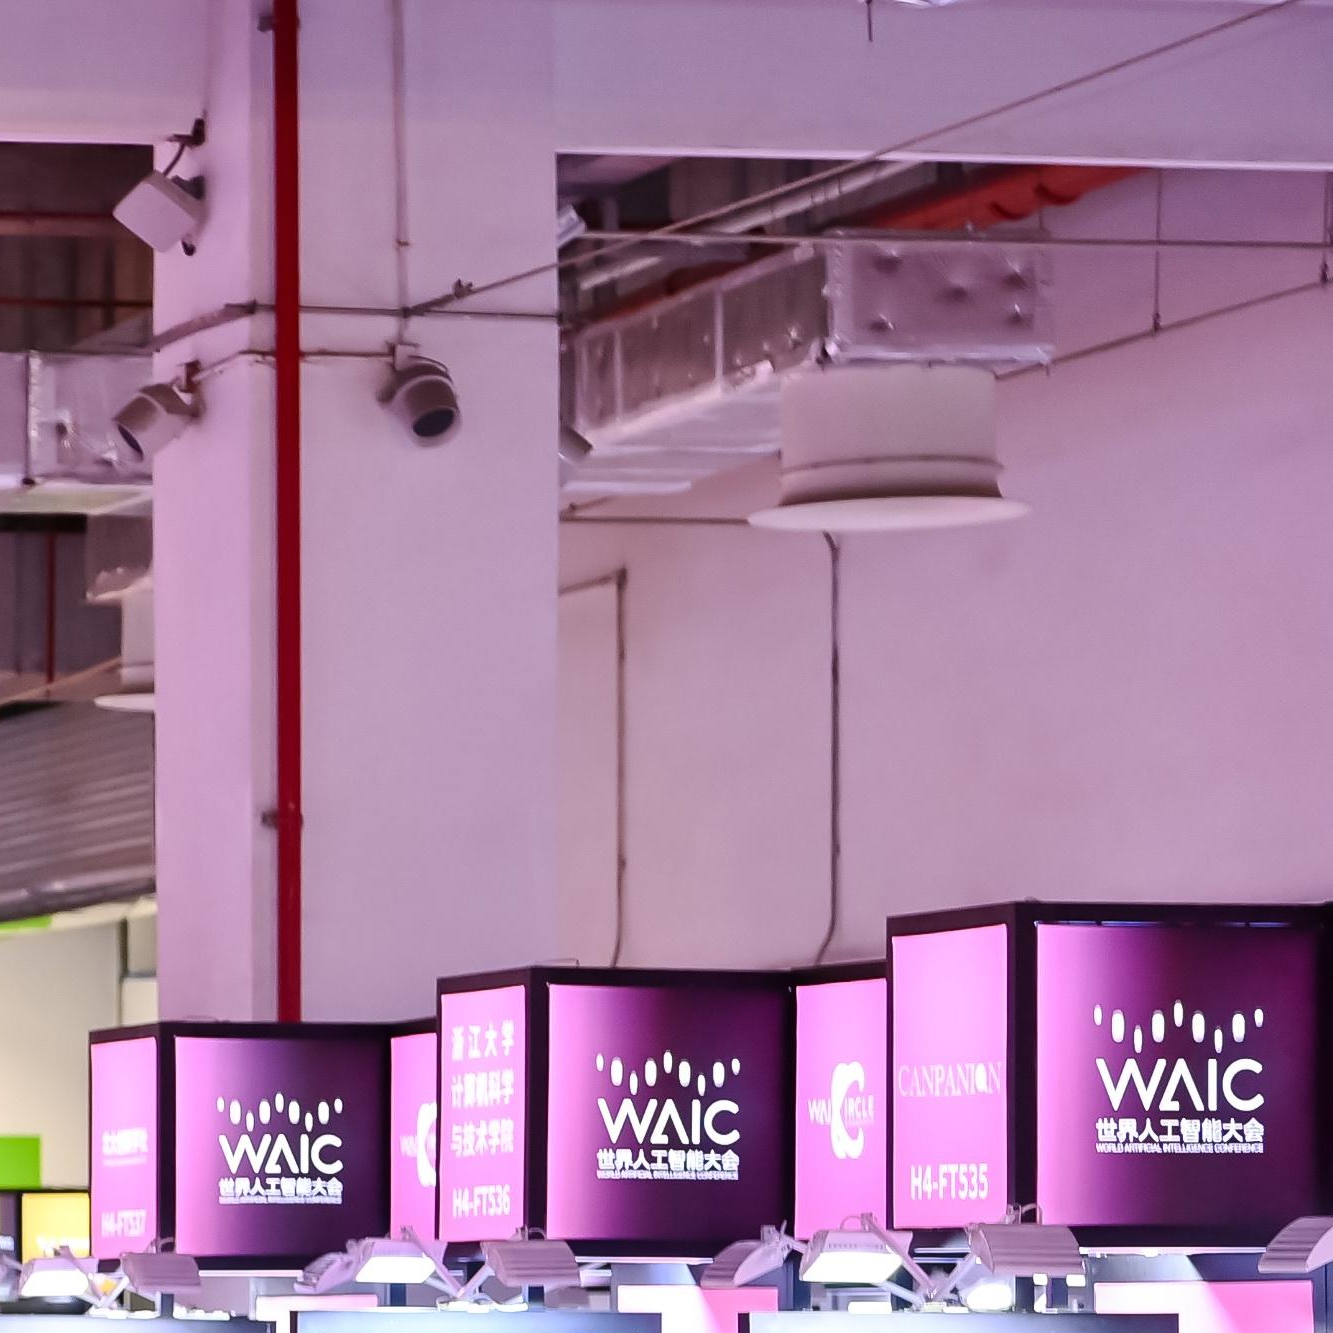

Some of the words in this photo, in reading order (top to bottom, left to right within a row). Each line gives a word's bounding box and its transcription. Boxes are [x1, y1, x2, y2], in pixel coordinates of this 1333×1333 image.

[451, 1020, 514, 1062] 浙江大学
[451, 1069, 514, 1109] 计算机科学
[1095, 1058, 1265, 1112] WAIC
[451, 1118, 514, 1158] 与技术学院
[597, 1098, 741, 1145] WAIC
[1095, 1117, 1265, 1142] 世界人工智能大会
[218, 1133, 344, 1175] WAIC
[597, 1148, 740, 1171] 世界人工智能大会
[452, 1184, 511, 1218] H4-FT536
[910, 1163, 989, 1200] H4-FT535
